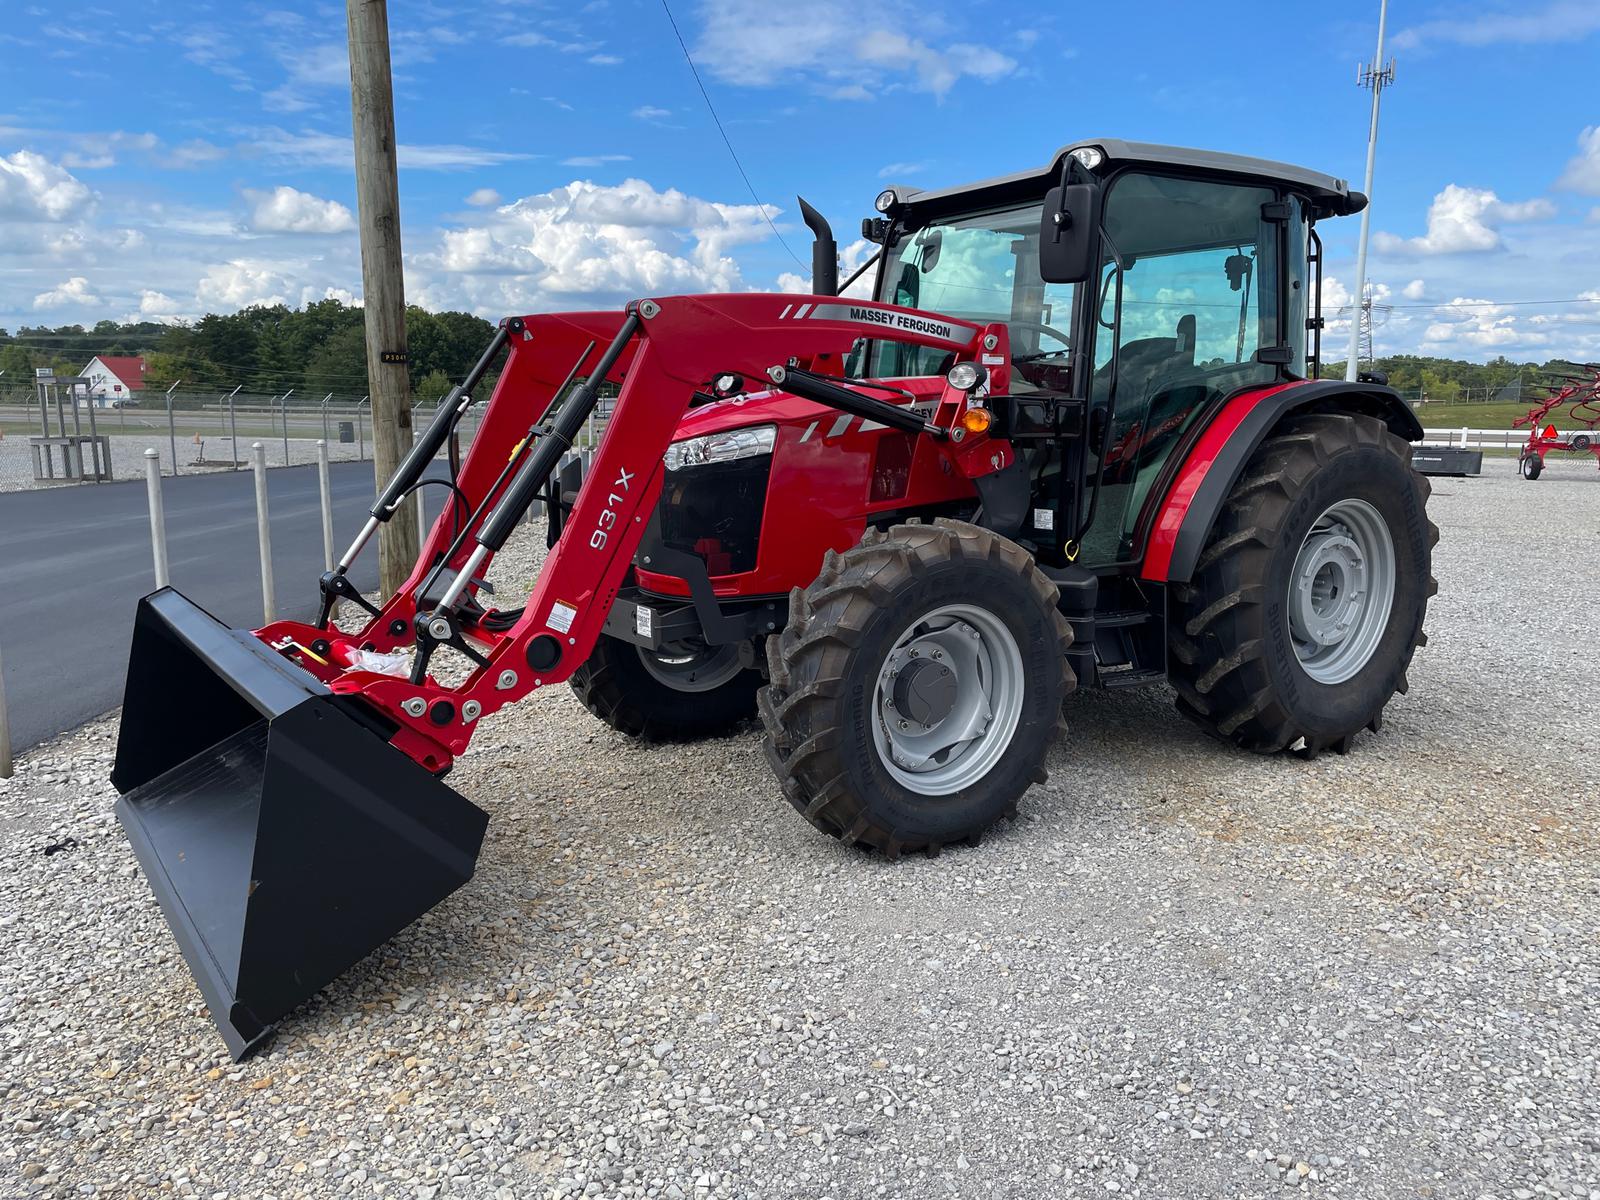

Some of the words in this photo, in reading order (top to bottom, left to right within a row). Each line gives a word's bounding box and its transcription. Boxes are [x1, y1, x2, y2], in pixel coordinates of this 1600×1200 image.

[850, 307, 895, 325] MASSEY
[897, 316, 951, 338] FERGUSON
[1268, 602, 1300, 711] TRELLEBORG
